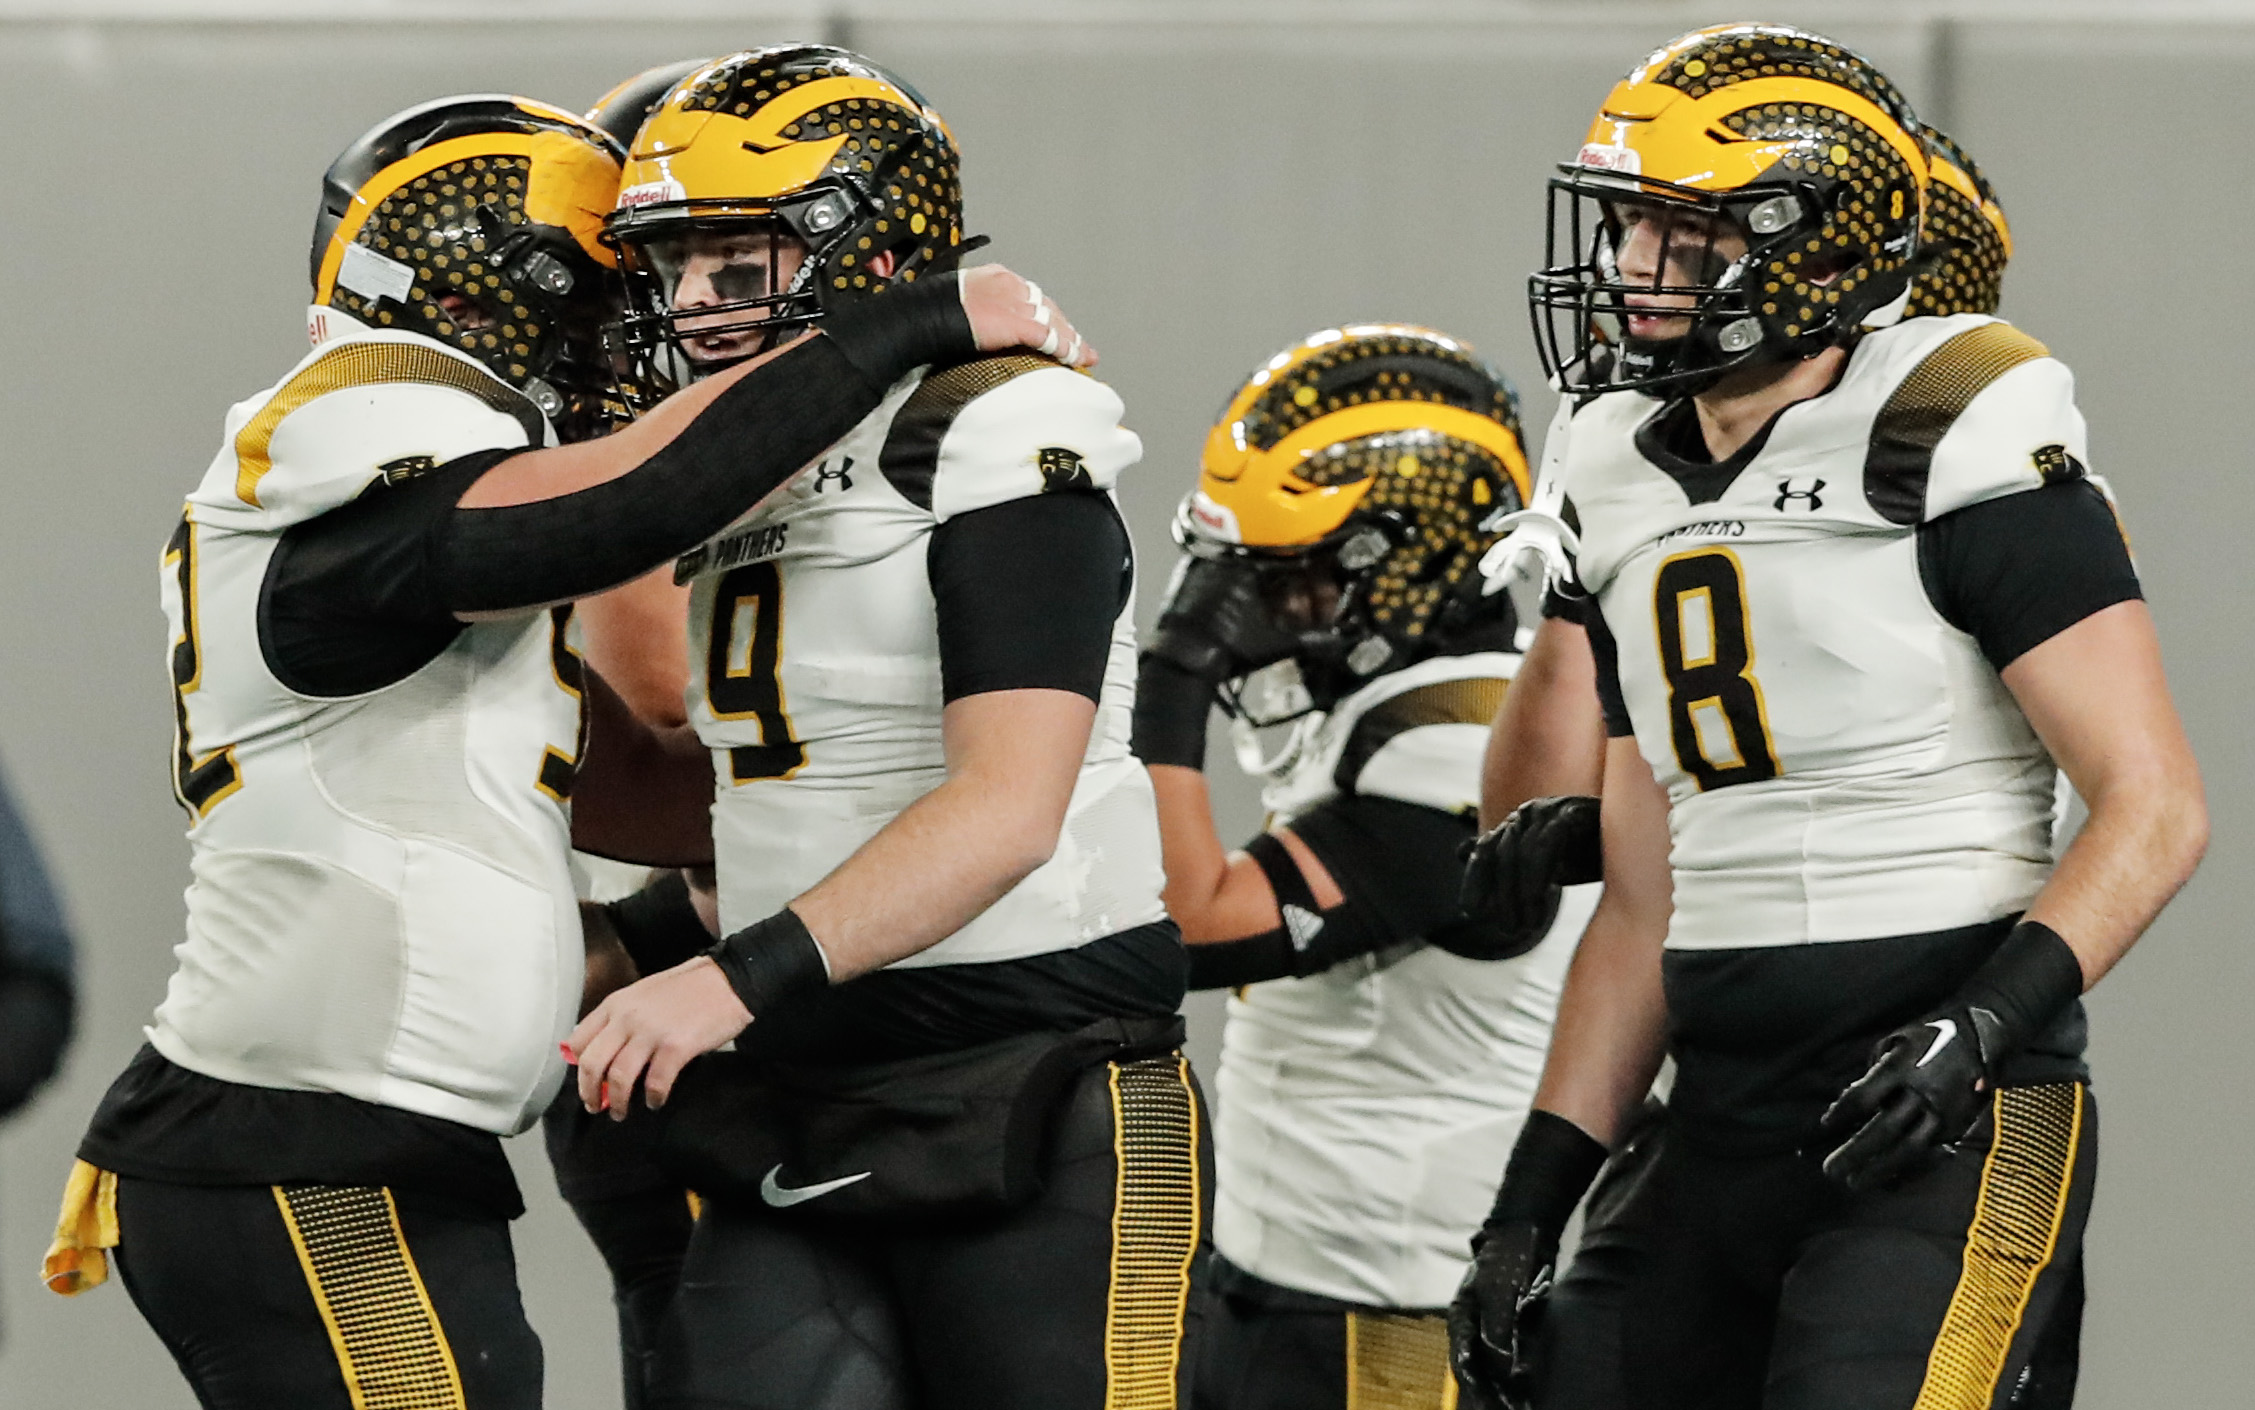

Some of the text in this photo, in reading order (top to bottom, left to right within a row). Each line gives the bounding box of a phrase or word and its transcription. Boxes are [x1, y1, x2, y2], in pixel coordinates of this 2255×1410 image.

[622, 186, 671, 207] Riddell
[1890, 190, 1904, 220] 8
[713, 522, 788, 569] PANTHERS
[706, 560, 810, 786] 9
[1652, 544, 1785, 793] 8
